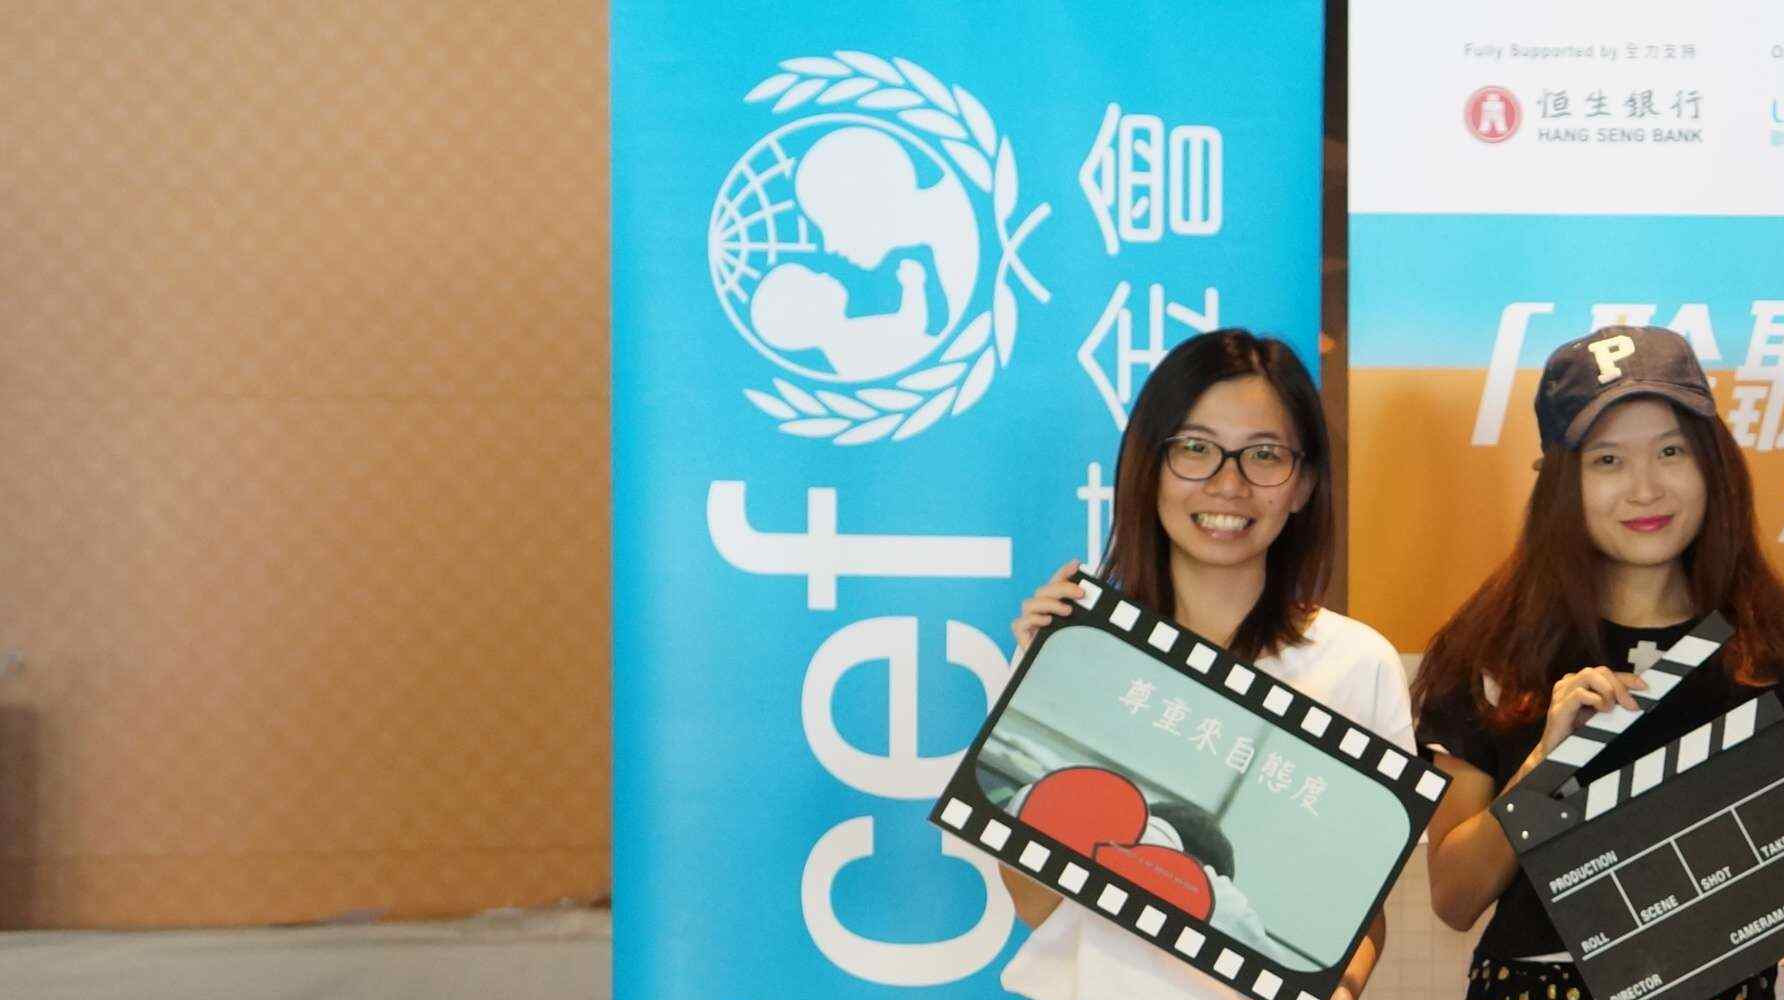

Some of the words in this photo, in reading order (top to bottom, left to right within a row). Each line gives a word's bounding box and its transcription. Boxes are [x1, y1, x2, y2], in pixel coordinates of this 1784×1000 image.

[1464, 42, 1503, 61] Fully
[1511, 42, 1594, 62] Supported
[1600, 43, 1618, 62] by
[1537, 88, 1704, 120] 恒生銀行
[1537, 127, 1589, 144] HANG
[1596, 127, 1645, 144] SENG
[1652, 127, 1703, 144] BANK
[1587, 334, 1636, 385] P
[1549, 850, 1619, 895] PRODUCTION
[1581, 931, 1611, 955] ROLL
[1640, 894, 1680, 924] SCENE
[1700, 866, 1733, 892] SHOT
